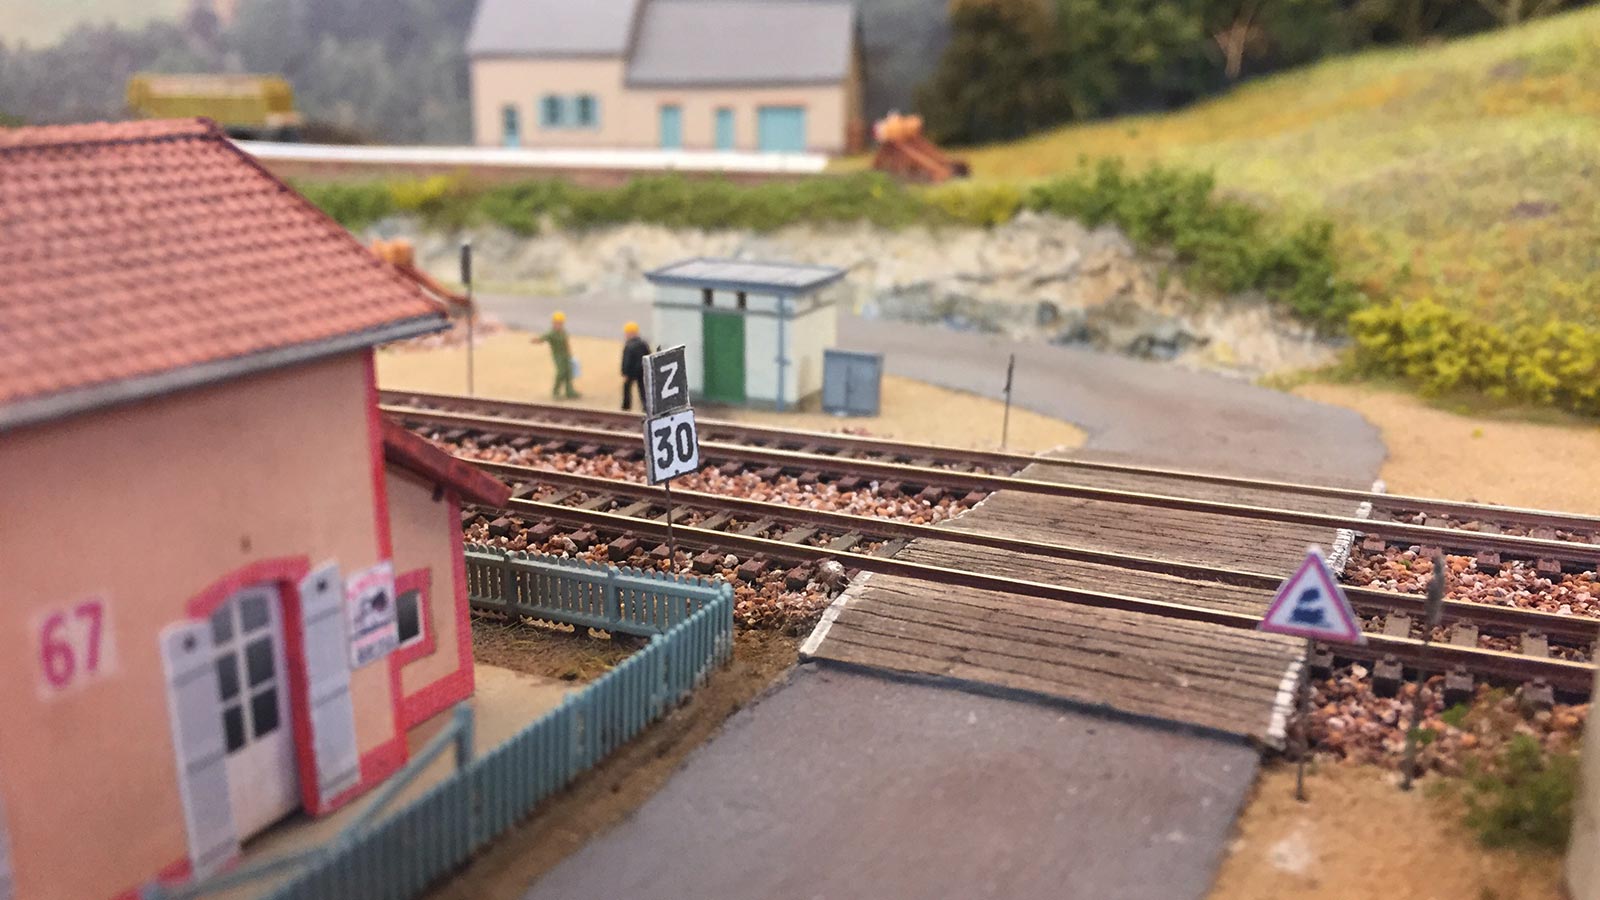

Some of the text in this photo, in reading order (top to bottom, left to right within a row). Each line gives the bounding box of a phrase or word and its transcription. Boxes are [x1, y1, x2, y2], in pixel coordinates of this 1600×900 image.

[660, 361, 679, 399] Z
[654, 422, 694, 469] 30
[41, 602, 102, 687] 67
